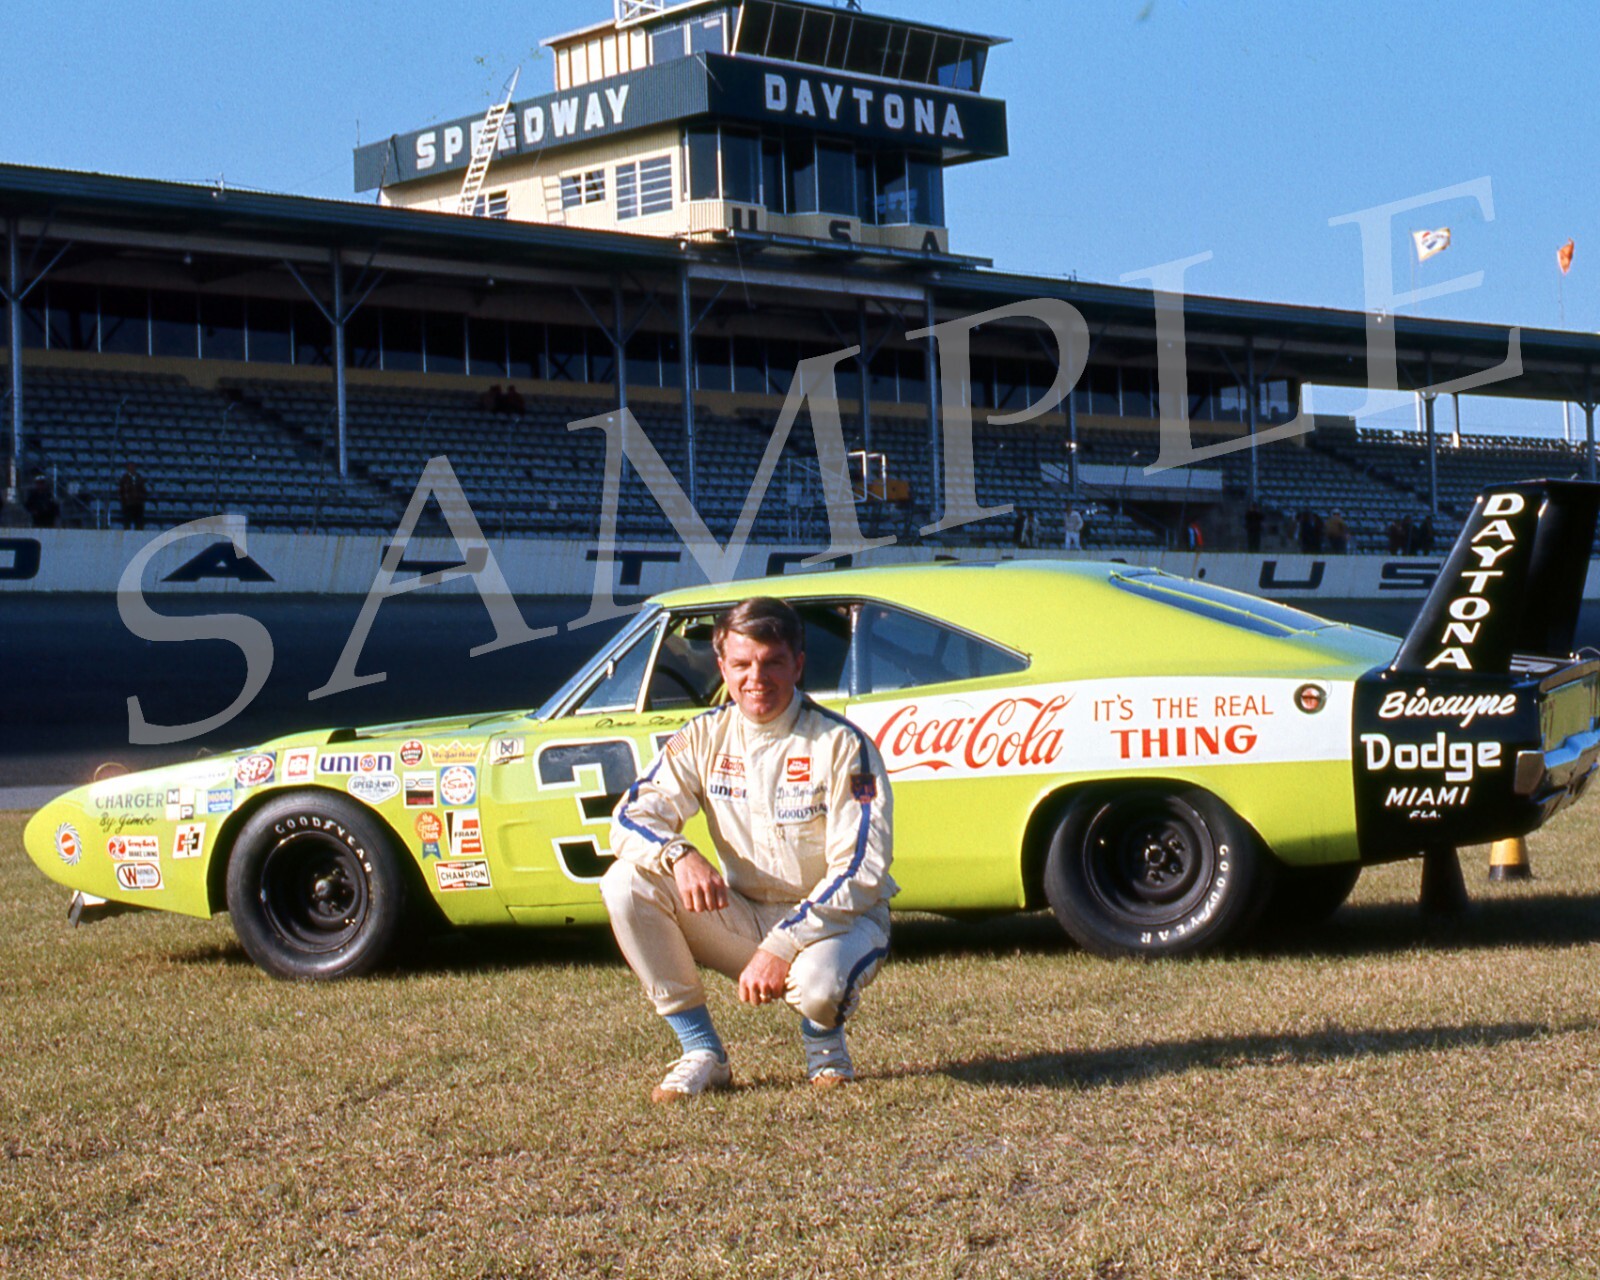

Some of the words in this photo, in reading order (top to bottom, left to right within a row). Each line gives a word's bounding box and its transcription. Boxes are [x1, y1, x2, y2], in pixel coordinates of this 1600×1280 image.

[764, 73, 965, 139] DAYTONA
[1425, 493, 1525, 670] DAYTONA
[874, 691, 1076, 773] Coca-Cola
[1093, 694, 1133, 722] IT'S
[1153, 697, 1198, 719] THE
[1214, 694, 1274, 717] REAL
[1378, 687, 1517, 728] Biscayne
[1110, 725, 1258, 759] THING
[1360, 731, 1502, 782] Dodge
[95, 791, 165, 809] CHARGER
[533, 730, 677, 884] 3
[1385, 786, 1471, 807] MIAMI
[275, 816, 372, 873] GOODYEAR
[440, 869, 486, 881] CHAMPION
[1141, 844, 1229, 943] GOODYEAR
